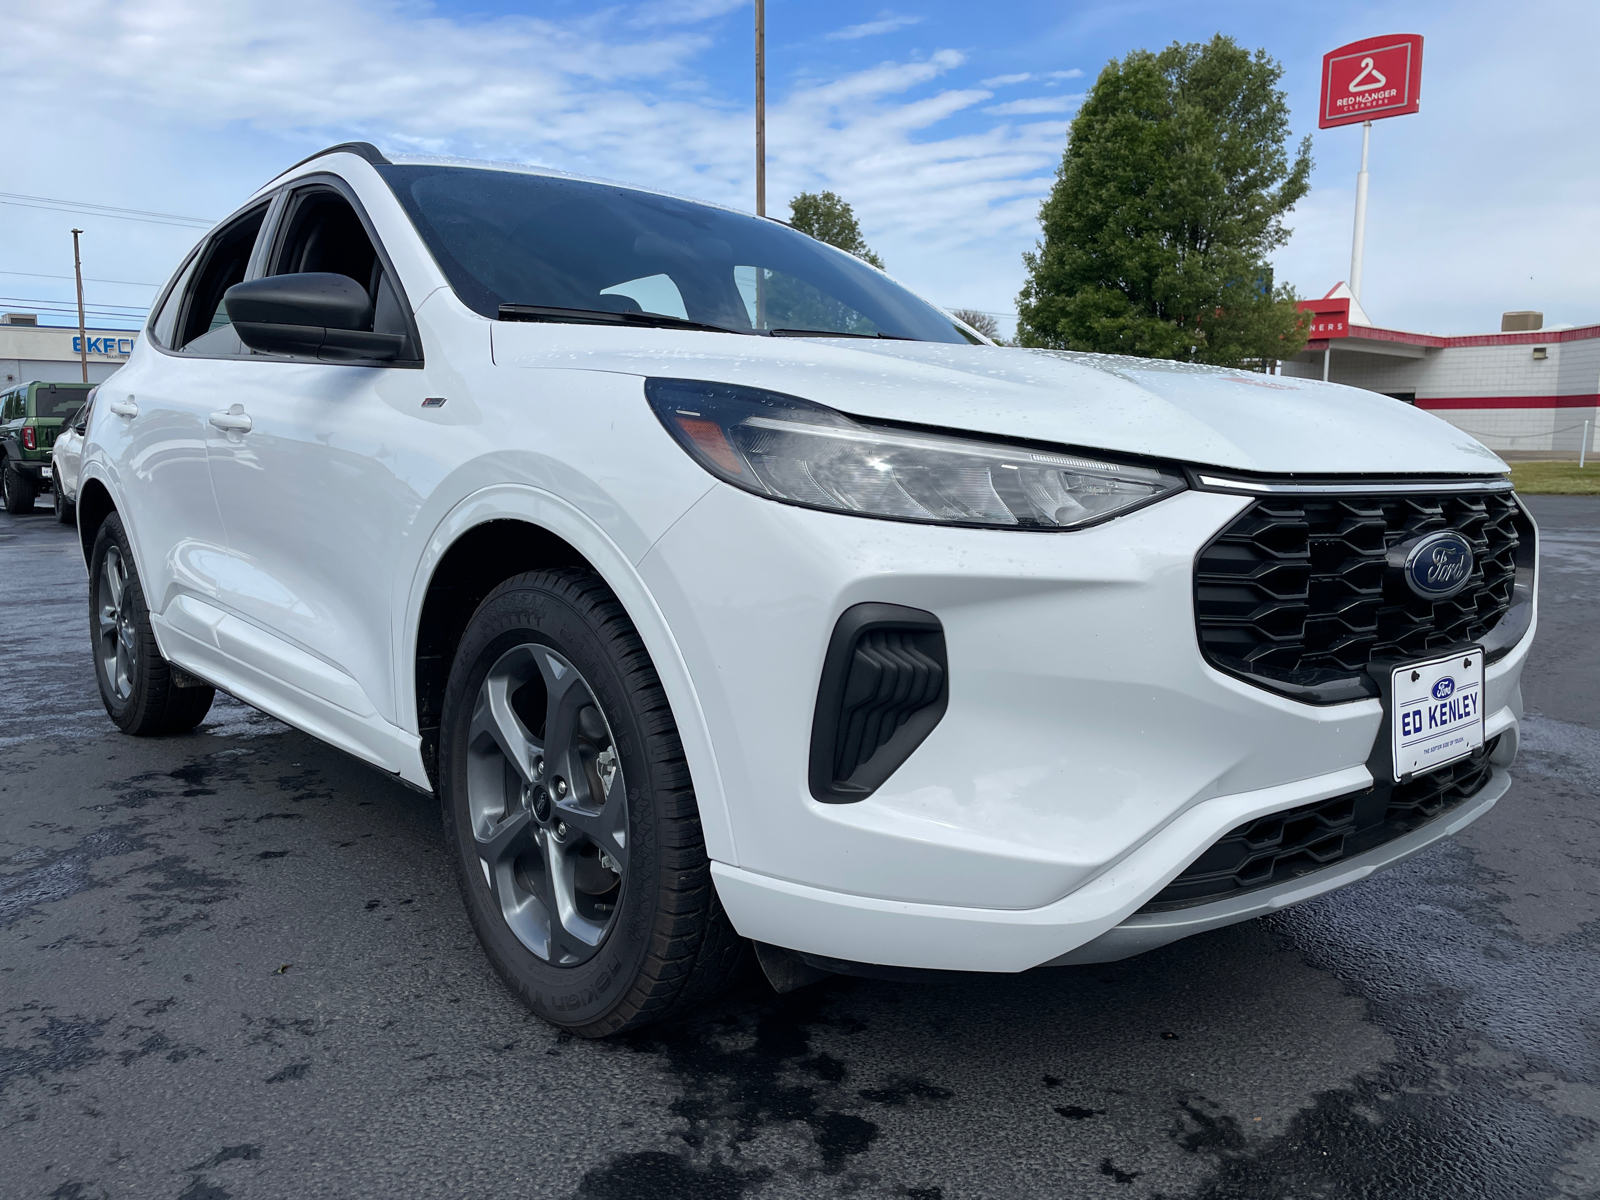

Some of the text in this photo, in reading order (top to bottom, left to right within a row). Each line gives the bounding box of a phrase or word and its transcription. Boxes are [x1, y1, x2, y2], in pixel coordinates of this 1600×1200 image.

[1336, 88, 1397, 107] RED HANGER
[1343, 98, 1389, 111] CLEANERS
[1309, 322, 1343, 332] NERS
[72, 336, 134, 354] EKFC
[1428, 546, 1465, 583] Ford
[1436, 680, 1452, 698] Ford
[1402, 691, 1478, 737] ED KENLEY
